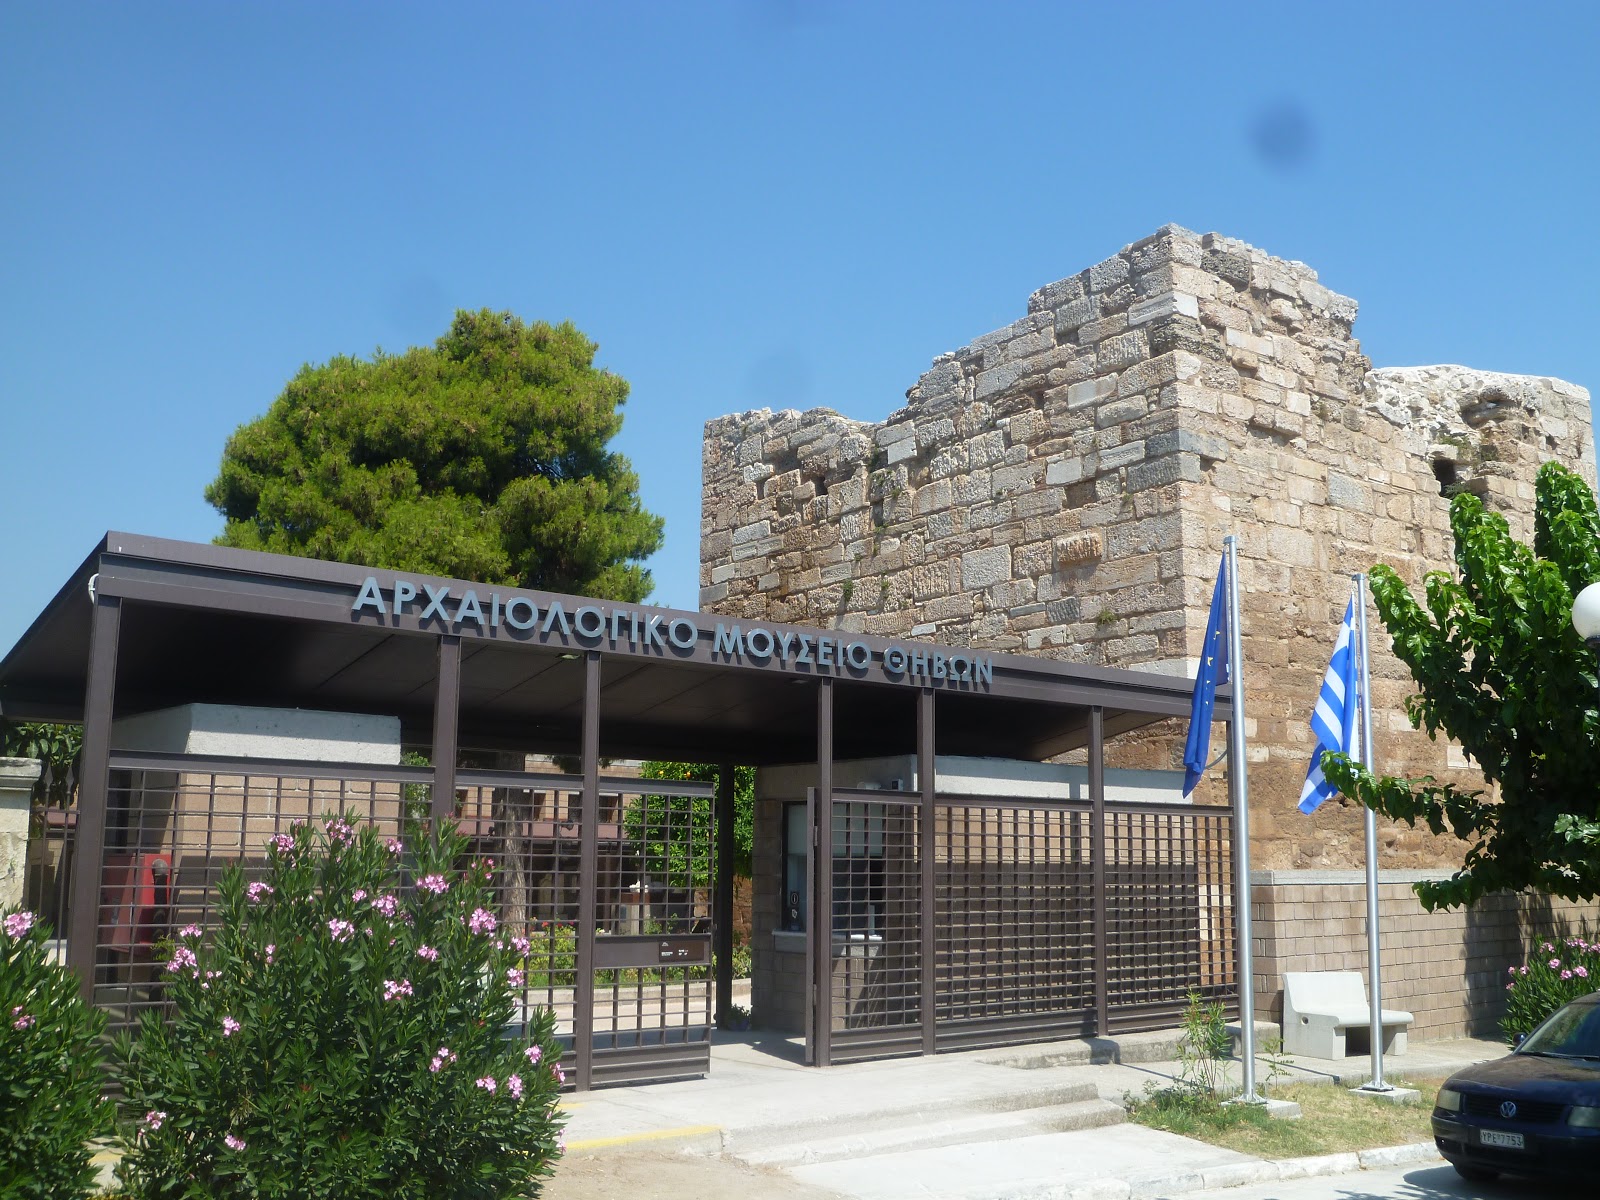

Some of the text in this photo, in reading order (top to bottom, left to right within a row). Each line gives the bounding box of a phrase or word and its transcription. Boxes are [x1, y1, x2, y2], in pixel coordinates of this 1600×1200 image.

[351, 577, 993, 684] ΑΡΧΑΙΟΛΟΓΙΚΟ ΜΟΥΣΕΙΟ ΘΗΒΩΝ
